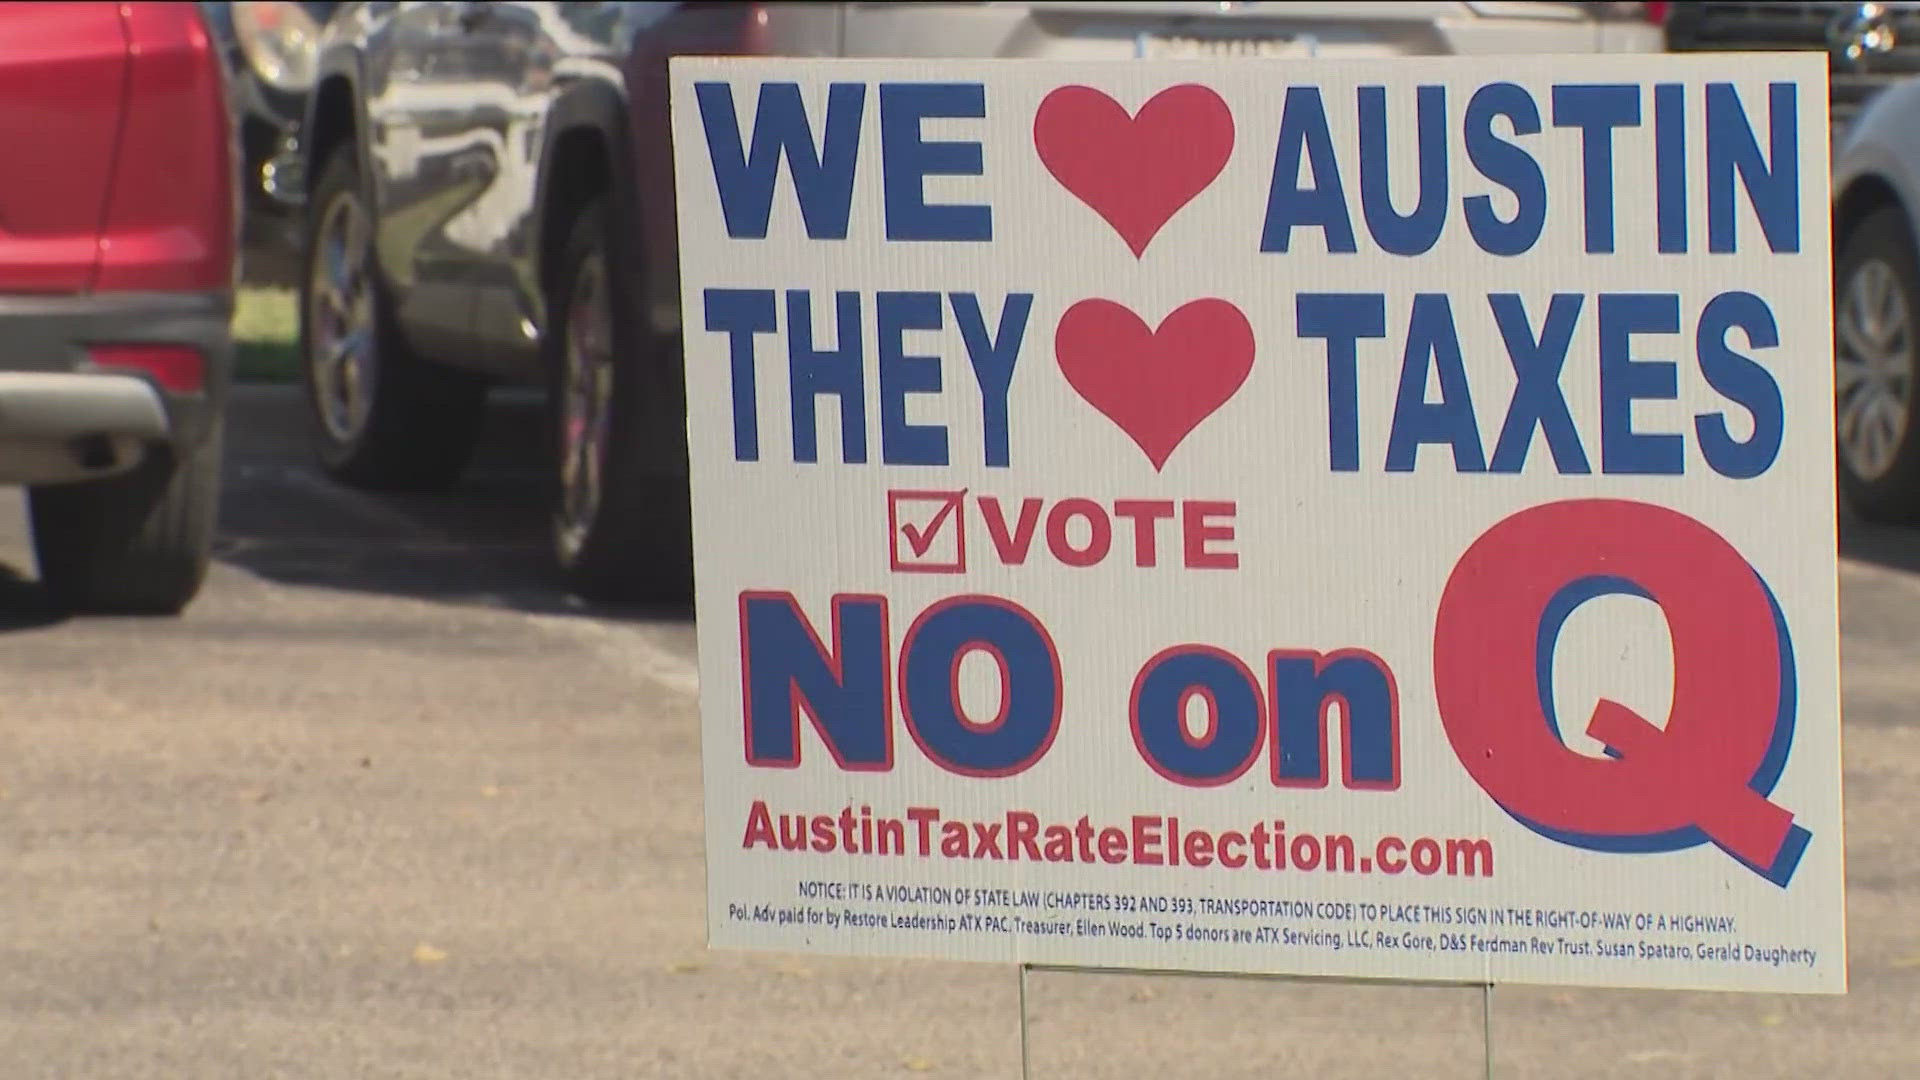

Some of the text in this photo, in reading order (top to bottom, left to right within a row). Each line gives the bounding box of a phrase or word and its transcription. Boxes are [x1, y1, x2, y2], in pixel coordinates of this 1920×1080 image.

[694, 82, 1800, 257] WE AUSTIN
[703, 288, 1784, 479] THEY TAXES
[977, 497, 1239, 569] VOTE
[740, 498, 1811, 888] NO on Q
[743, 800, 1495, 877] AustinTaxRateElection.com
[729, 903, 750, 921] Pol.
[753, 903, 776, 922] Adv
[779, 905, 804, 926] paid
[806, 906, 823, 925] for
[826, 907, 840, 929] by
[844, 909, 888, 928] Restore
[891, 912, 956, 930] Leadership
[959, 913, 982, 932] ATX
[1014, 916, 1073, 936] Treasurer,
[1077, 919, 1105, 937] Ellen
[1108, 921, 1147, 938] Wood.
[1149, 922, 1172, 943] Top
[1176, 923, 1182, 940] 5
[1186, 924, 1229, 942] donors
[1232, 929, 1252, 944] are
[1255, 926, 1279, 944] ATX
[1283, 928, 1343, 949] Servicing,
[1348, 930, 1372, 949] LLC,
[1376, 931, 1399, 948] Rex
[1402, 932, 1436, 951] Gore,
[1440, 933, 1466, 951] D&S
[1471, 934, 1527, 953] Ferdman
[1531, 936, 1554, 954] Rev
[1596, 940, 1635, 957] Susan
[1697, 942, 1740, 961] Gerald
[1744, 944, 1816, 967] Daugherty
[799, 881, 845, 900] NOTICE:
[849, 883, 860, 899] IT
[862, 884, 872, 901] IS
[876, 885, 884, 902] A
[886, 885, 951, 904] VIOLATION
[955, 888, 970, 906] OF
[974, 889, 1010, 906] STATE
[1013, 891, 1039, 908] LAW
[1115, 895, 1136, 912] 392
[1140, 896, 1168, 912] AND
[1172, 896, 1197, 915] 393,
[1199, 898, 1313, 918] TRANSPORTATION
[1359, 903, 1377, 921] TO
[1380, 904, 1420, 923] PLACE
[1423, 905, 1452, 924] THIS
[1456, 907, 1486, 925] SIGN
[1490, 909, 1504, 926] IN
[1507, 909, 1532, 926] THE
[1536, 910, 1631, 929] RIGHT-OF-WAY
[1635, 913, 1653, 931] OF
[1657, 914, 1666, 930] A
[1670, 915, 1736, 933] HIGHWAY.
